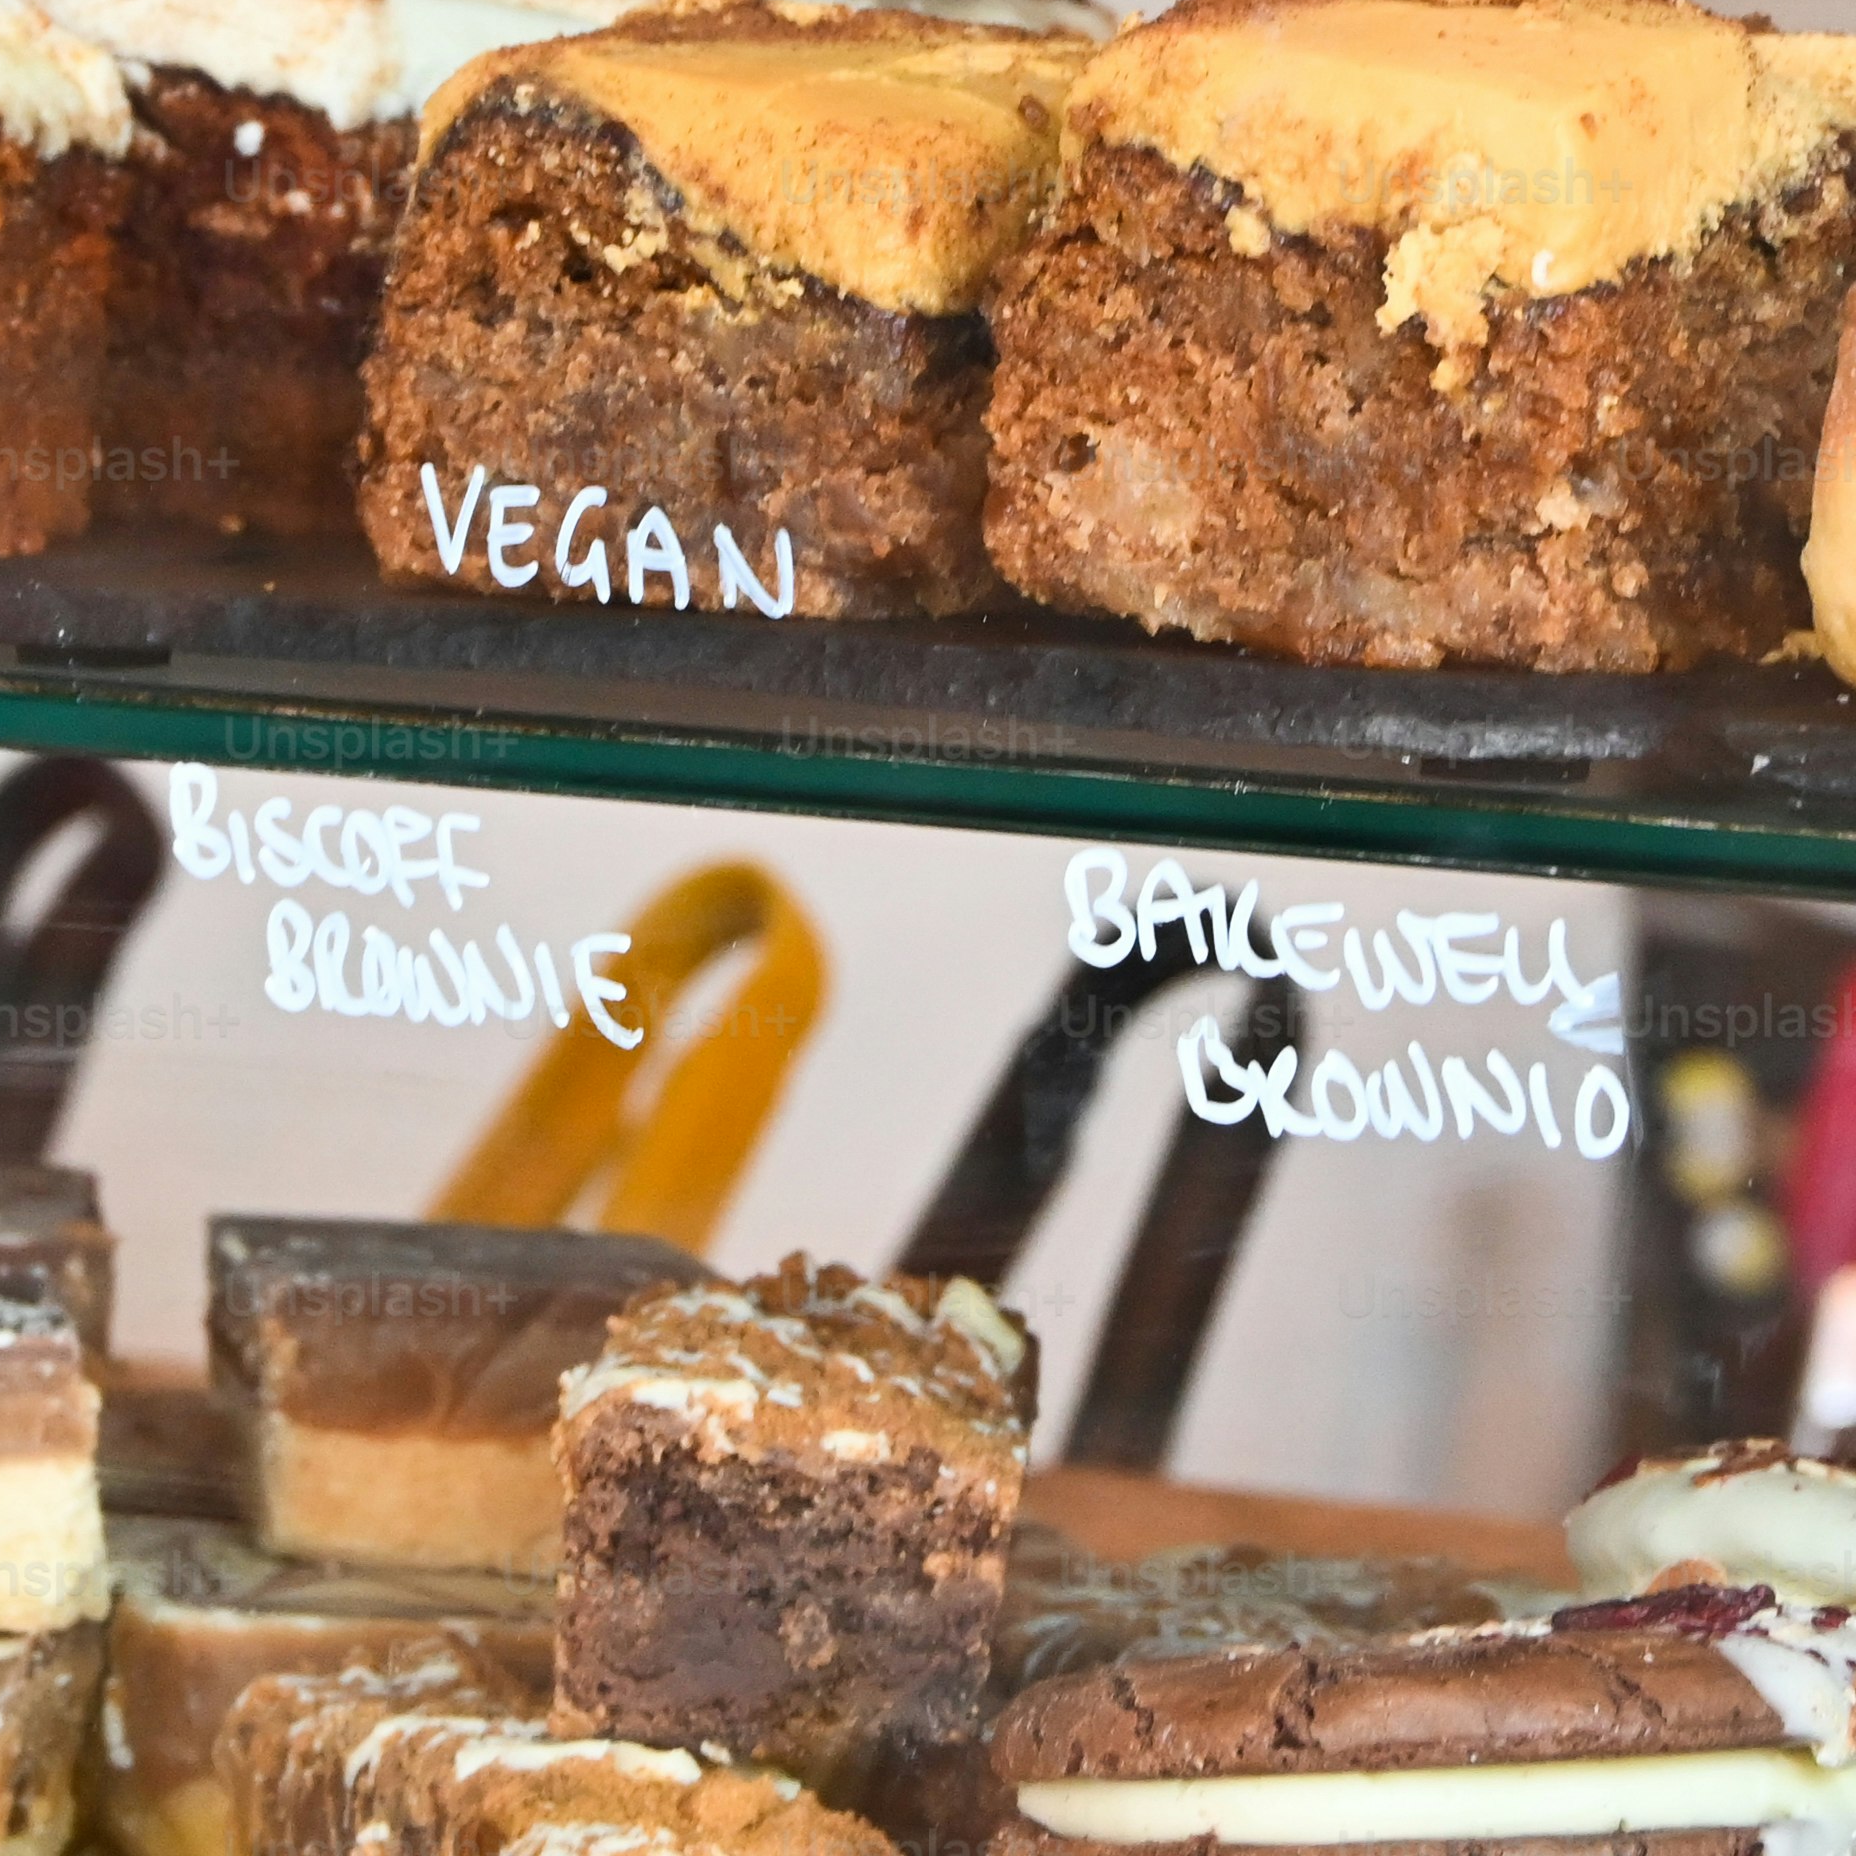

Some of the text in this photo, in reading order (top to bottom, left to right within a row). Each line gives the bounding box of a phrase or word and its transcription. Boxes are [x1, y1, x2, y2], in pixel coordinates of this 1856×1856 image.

[421, 463, 794, 620] VEGAN
[169, 761, 490, 911] BISCOFF
[264, 897, 644, 1051] BROWNIE
